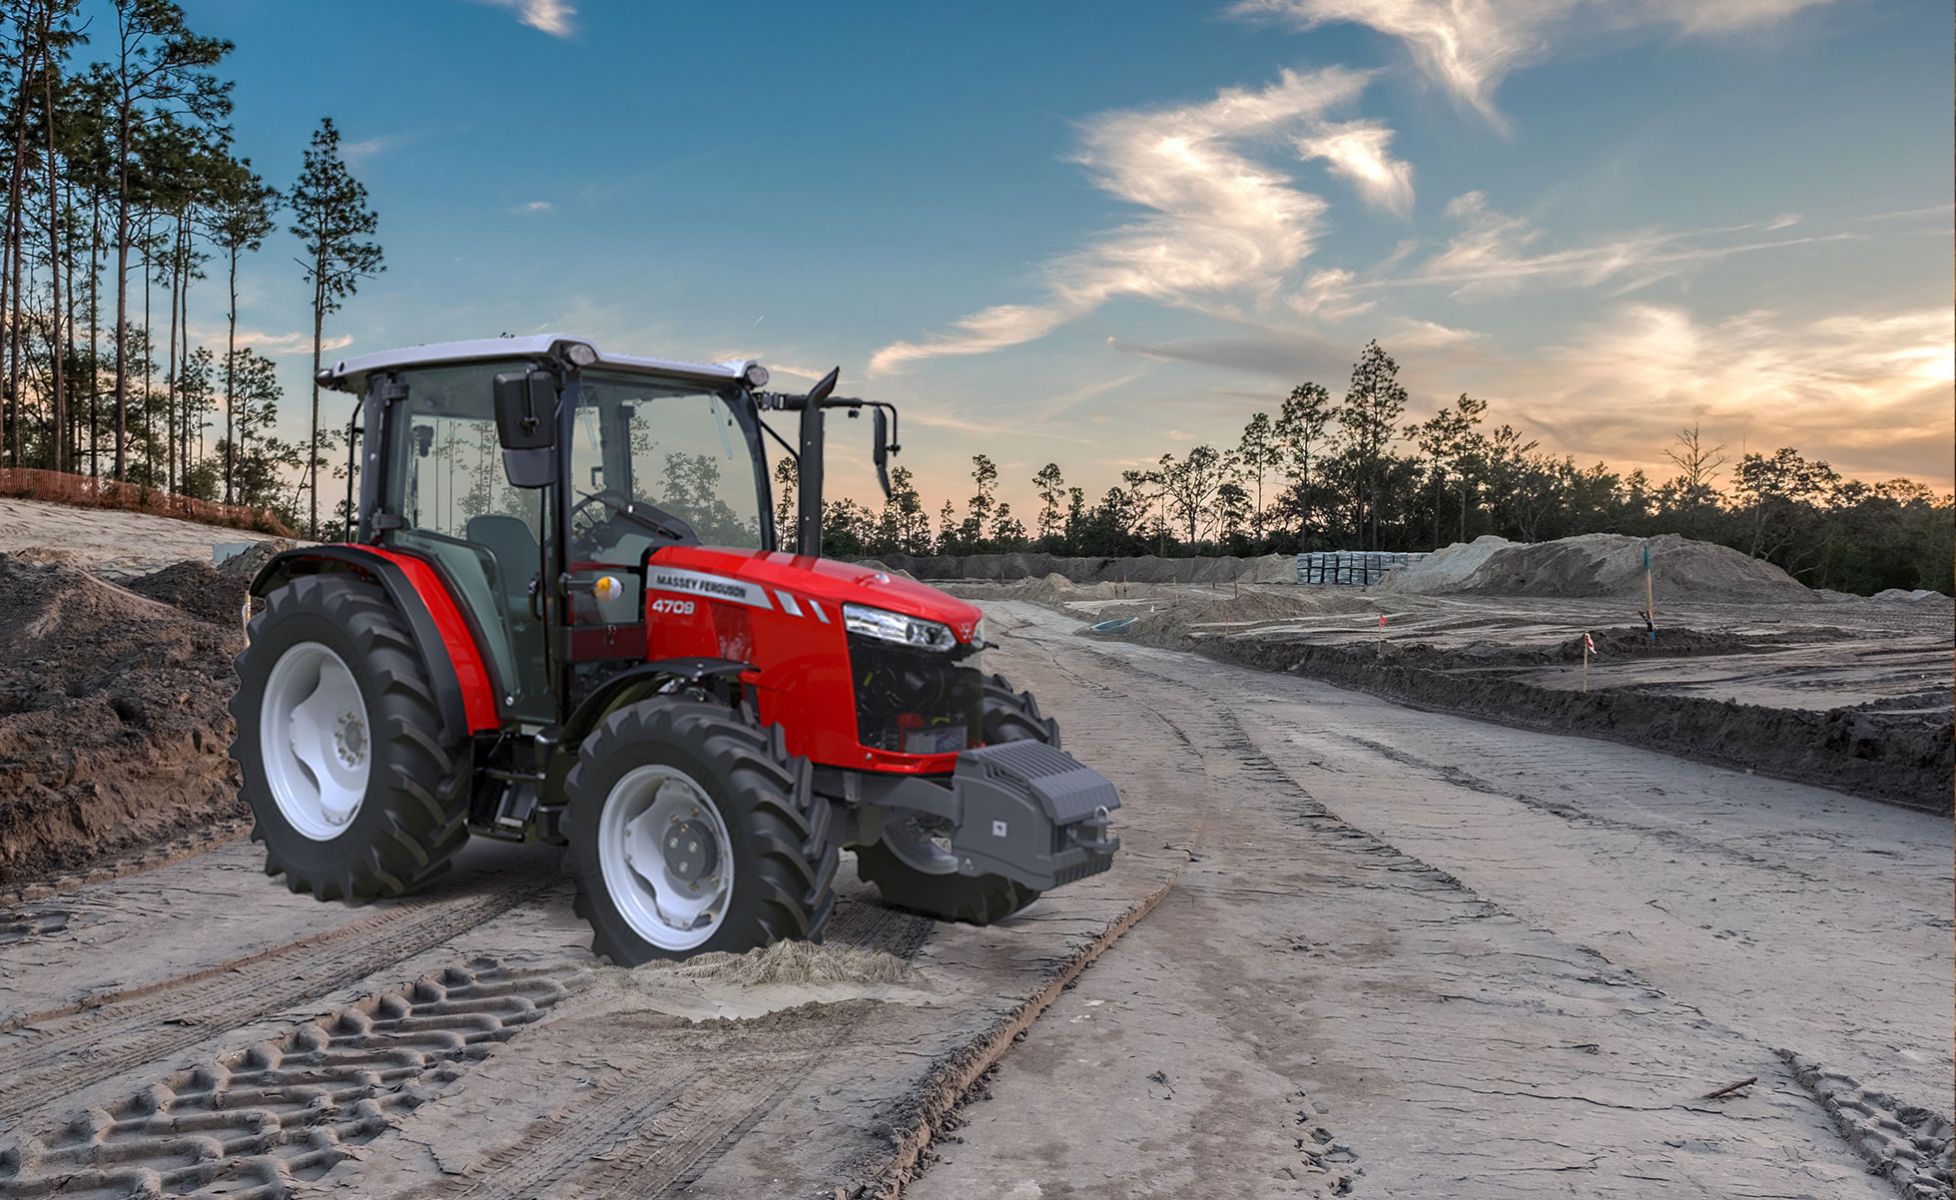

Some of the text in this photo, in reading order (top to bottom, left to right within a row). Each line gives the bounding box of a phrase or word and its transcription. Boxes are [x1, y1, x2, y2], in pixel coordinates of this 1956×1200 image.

[656, 575, 747, 599] MASSEY FERGUSON
[652, 599, 695, 615] 4709
